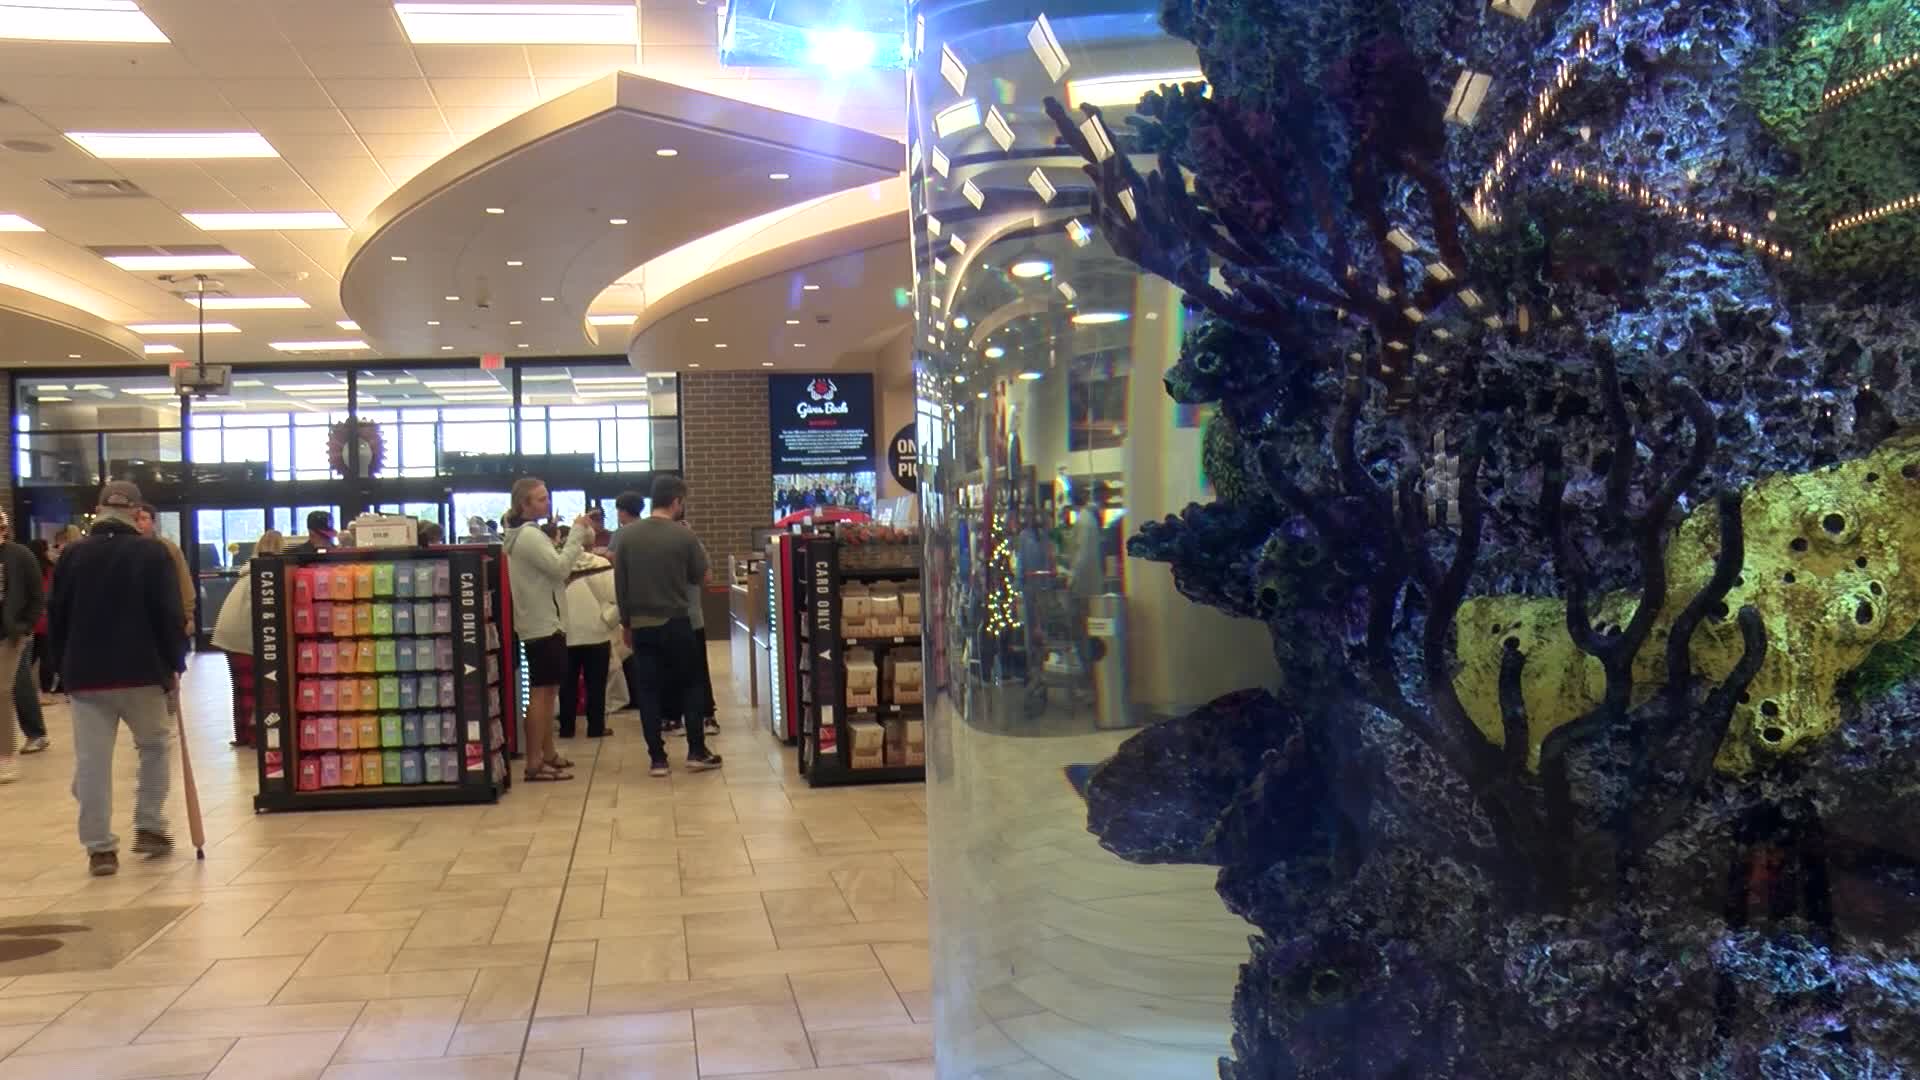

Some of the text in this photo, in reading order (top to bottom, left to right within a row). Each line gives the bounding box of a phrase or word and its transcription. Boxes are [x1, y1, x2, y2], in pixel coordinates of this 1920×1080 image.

[797, 402, 849, 418] Gives Back
[260, 571, 277, 661] CASH & CARD
[460, 572, 476, 644] CARD ONLY
[815, 561, 831, 631] CARD ONLY
